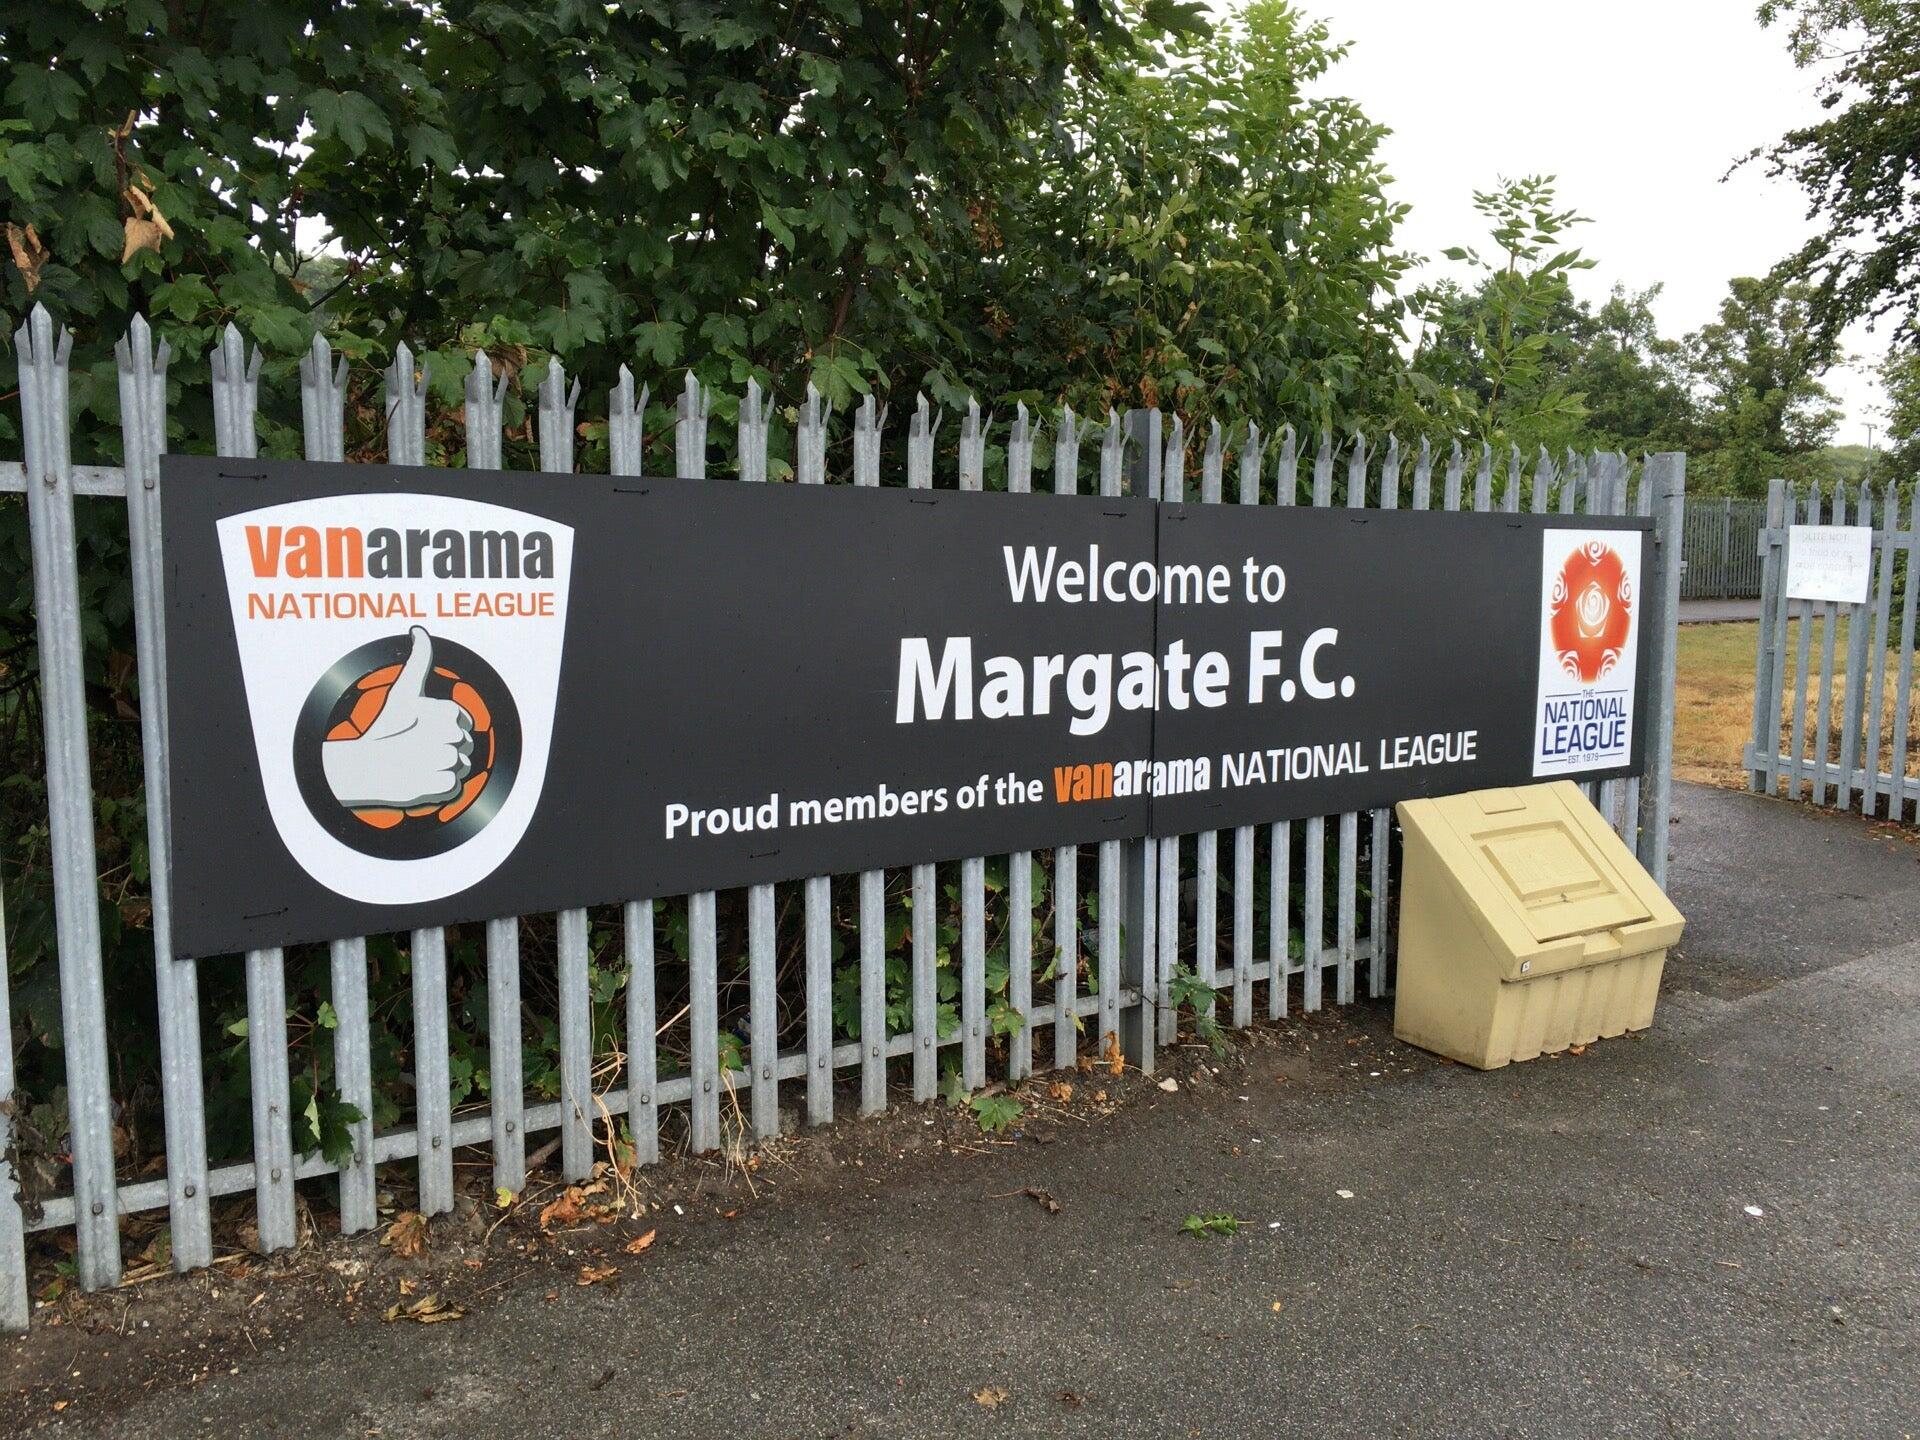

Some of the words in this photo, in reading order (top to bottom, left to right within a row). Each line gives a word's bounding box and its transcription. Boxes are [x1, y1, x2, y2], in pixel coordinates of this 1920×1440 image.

[245, 525, 555, 580] vanarama
[1003, 543, 1231, 605] Welcome
[1242, 556, 1286, 604] to
[248, 592, 427, 620] NATIONAL
[437, 592, 555, 618] LEAGUE
[895, 636, 1230, 737] Margate
[1248, 627, 1356, 705] F.C.
[1582, 689, 1595, 698] THE
[1544, 696, 1628, 724] NATIONAL
[1541, 719, 1626, 756] LEAGUE
[1567, 755, 1581, 764] EST.
[1583, 752, 1600, 762] 1979
[665, 792, 779, 840] Proud
[789, 783, 949, 827] members
[956, 774, 990, 810] of
[994, 772, 1044, 806] the
[1053, 756, 1211, 804] vanarama
[1221, 741, 1370, 789] NATIONAL
[1379, 729, 1478, 772] LEAGUE
